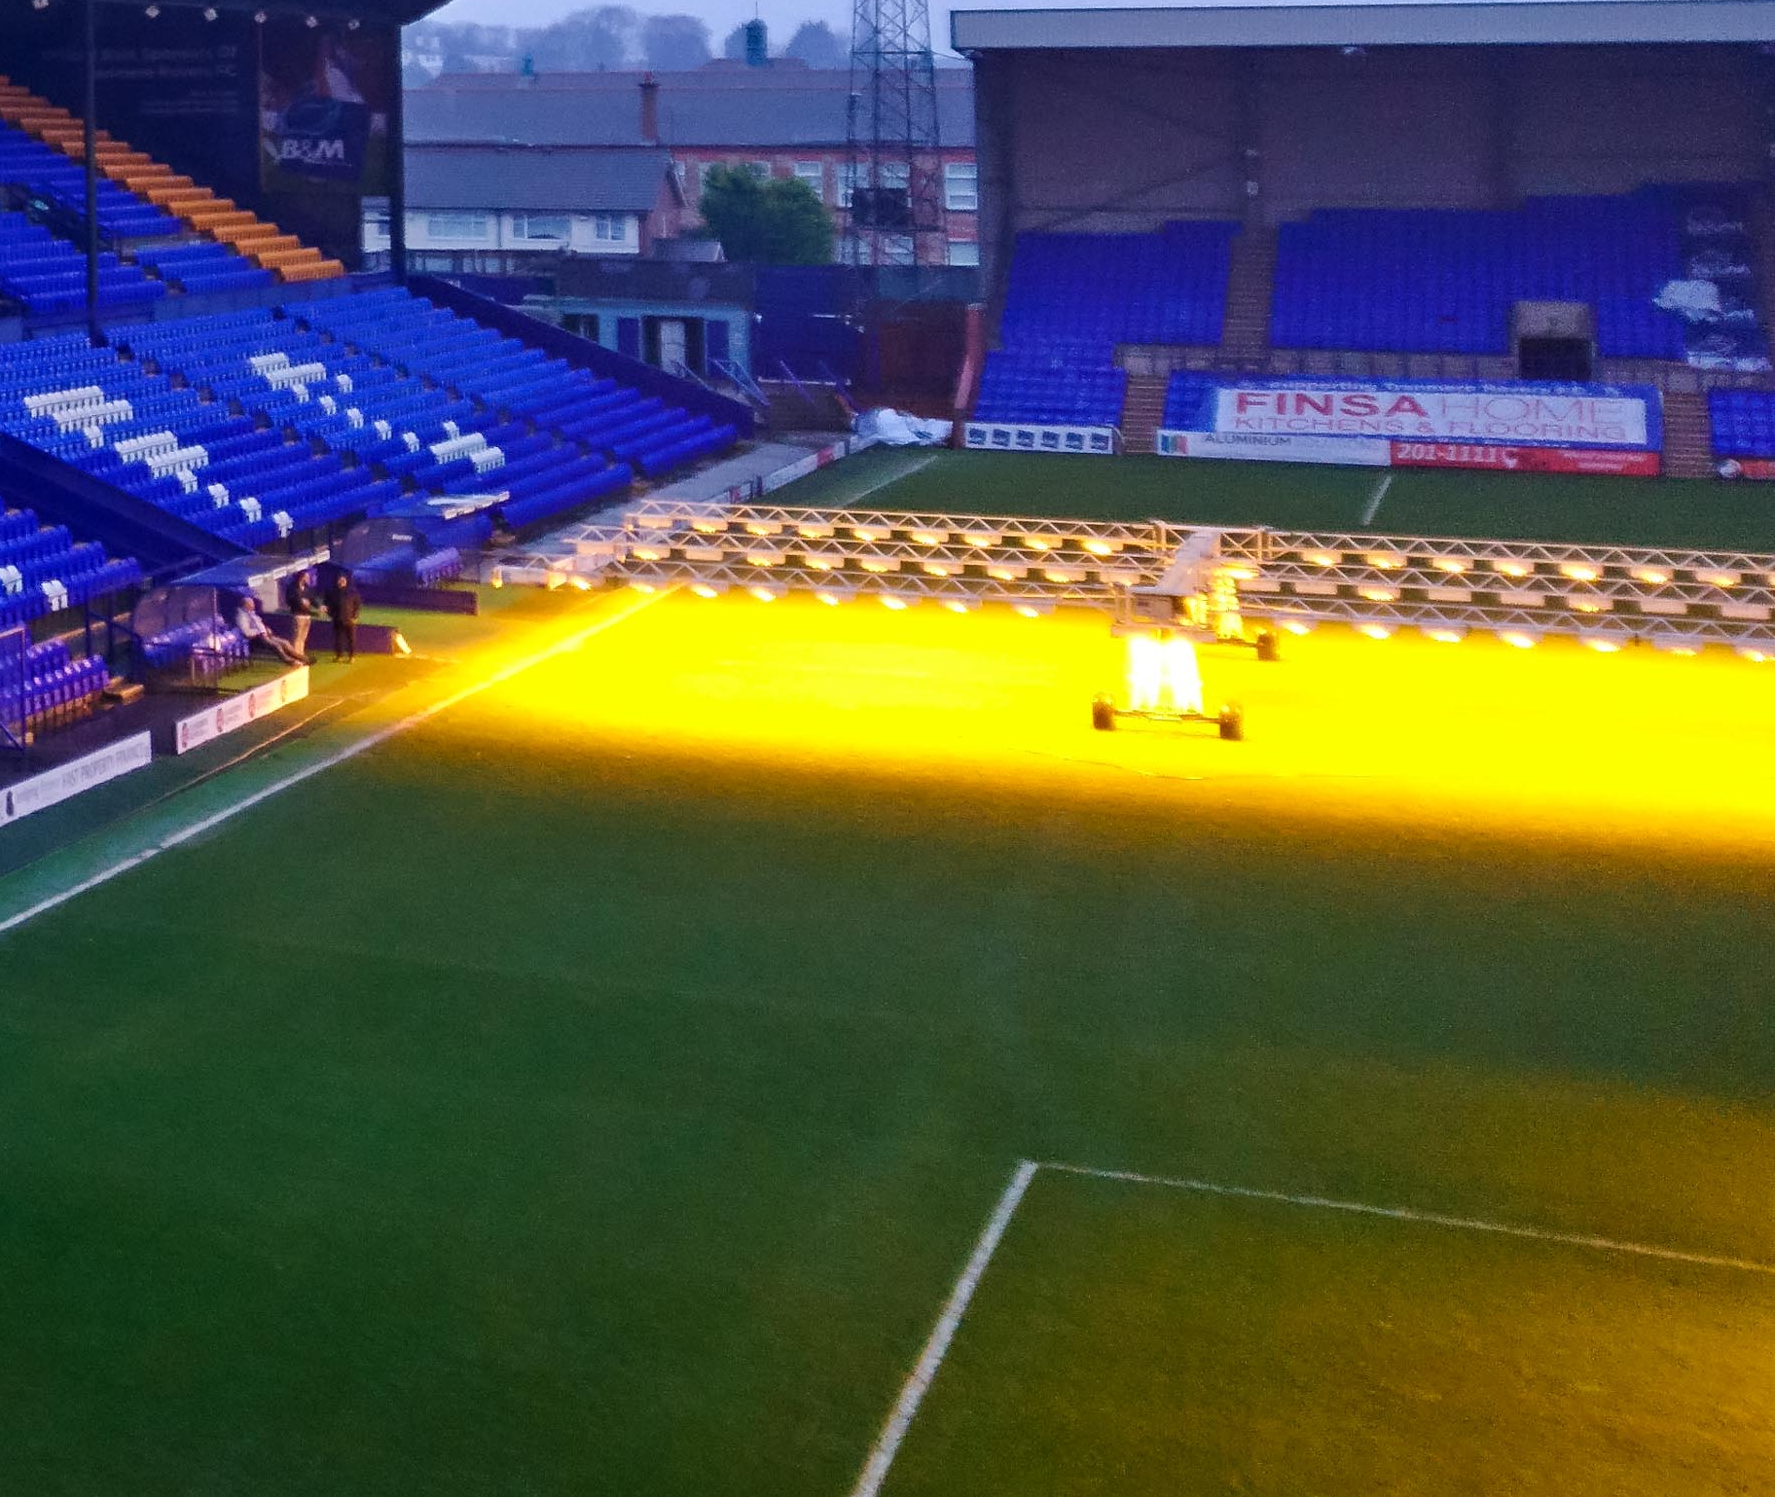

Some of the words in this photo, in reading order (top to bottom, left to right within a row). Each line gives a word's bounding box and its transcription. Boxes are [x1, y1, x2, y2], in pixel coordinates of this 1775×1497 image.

[1235, 391, 1429, 418] FINSA
[1442, 396, 1625, 424] HOME
[1205, 432, 1292, 447] ALUMINIUM
[1234, 416, 1411, 433] KITCHENS
[1416, 420, 1435, 434] &
[1451, 420, 1626, 441] FLOORING
